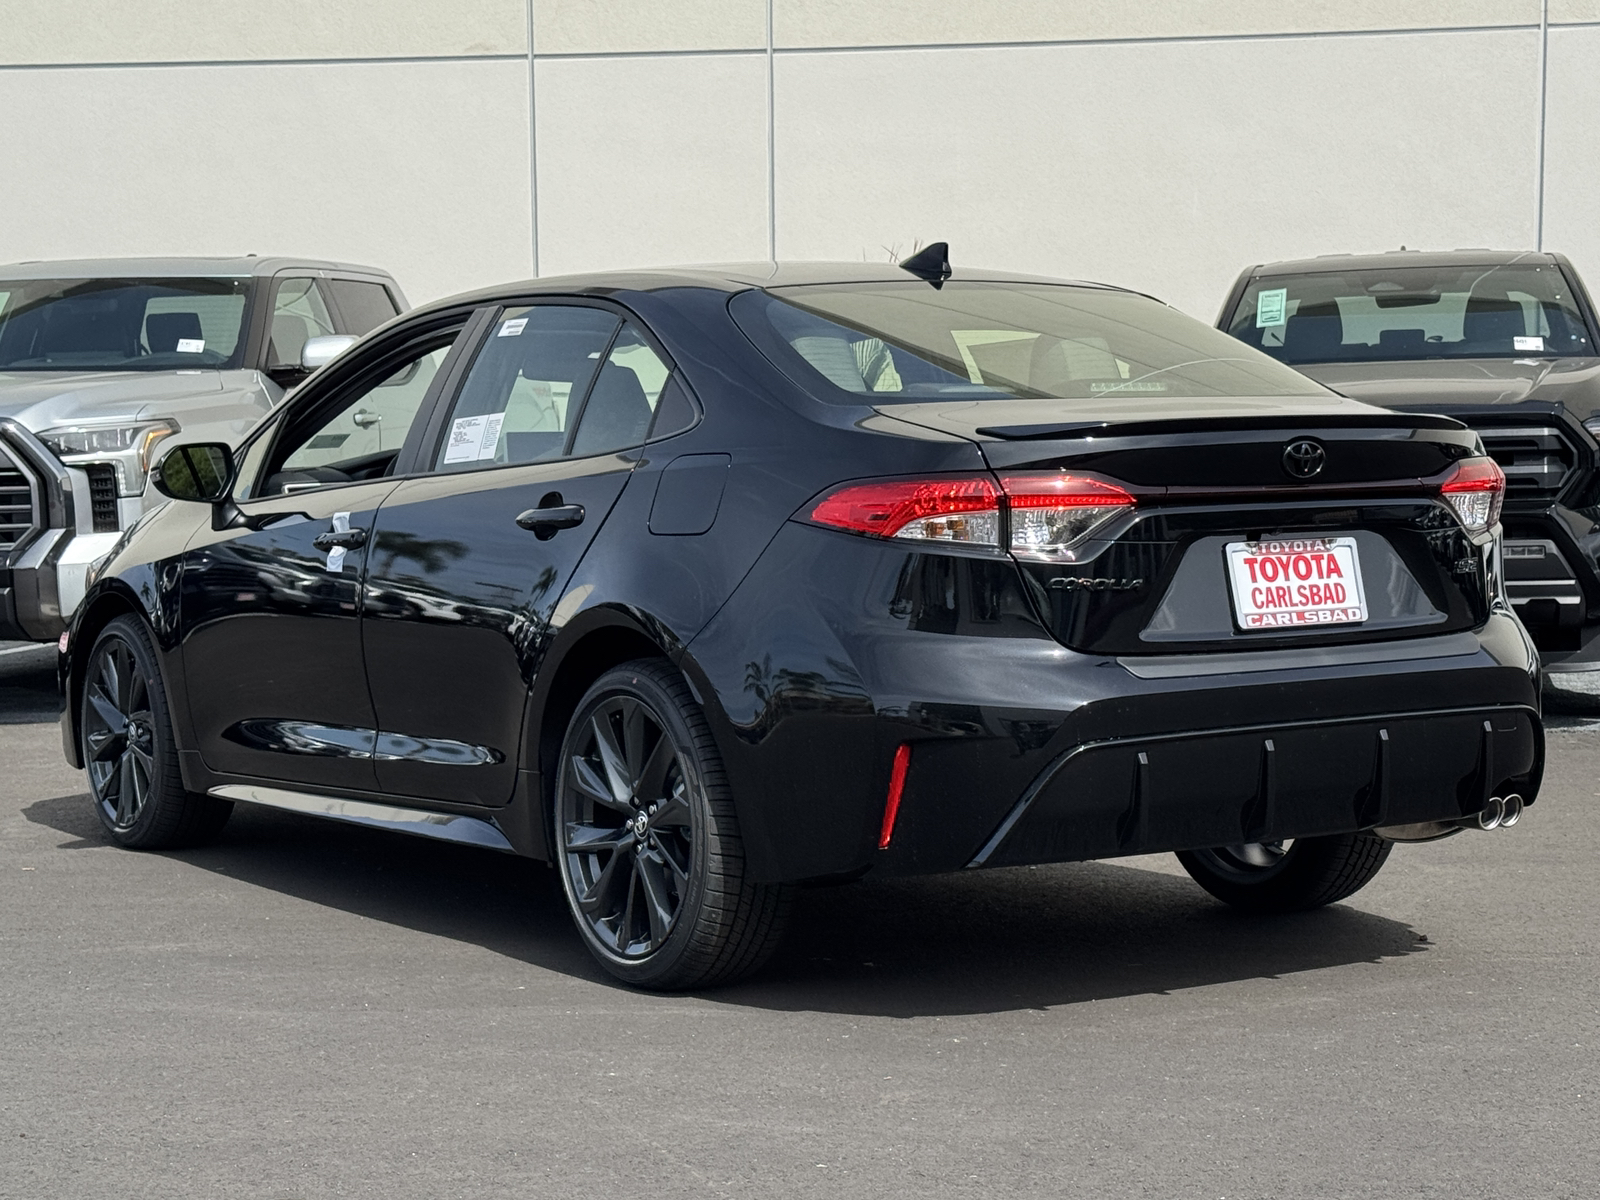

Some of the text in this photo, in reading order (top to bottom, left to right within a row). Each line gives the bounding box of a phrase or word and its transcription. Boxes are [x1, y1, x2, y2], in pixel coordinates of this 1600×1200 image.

[1259, 540, 1325, 554] TOYOTA
[1243, 553, 1344, 583] TOYOTA
[1251, 582, 1347, 610] CARLSBAD
[1246, 608, 1362, 627] CARLSBAD
